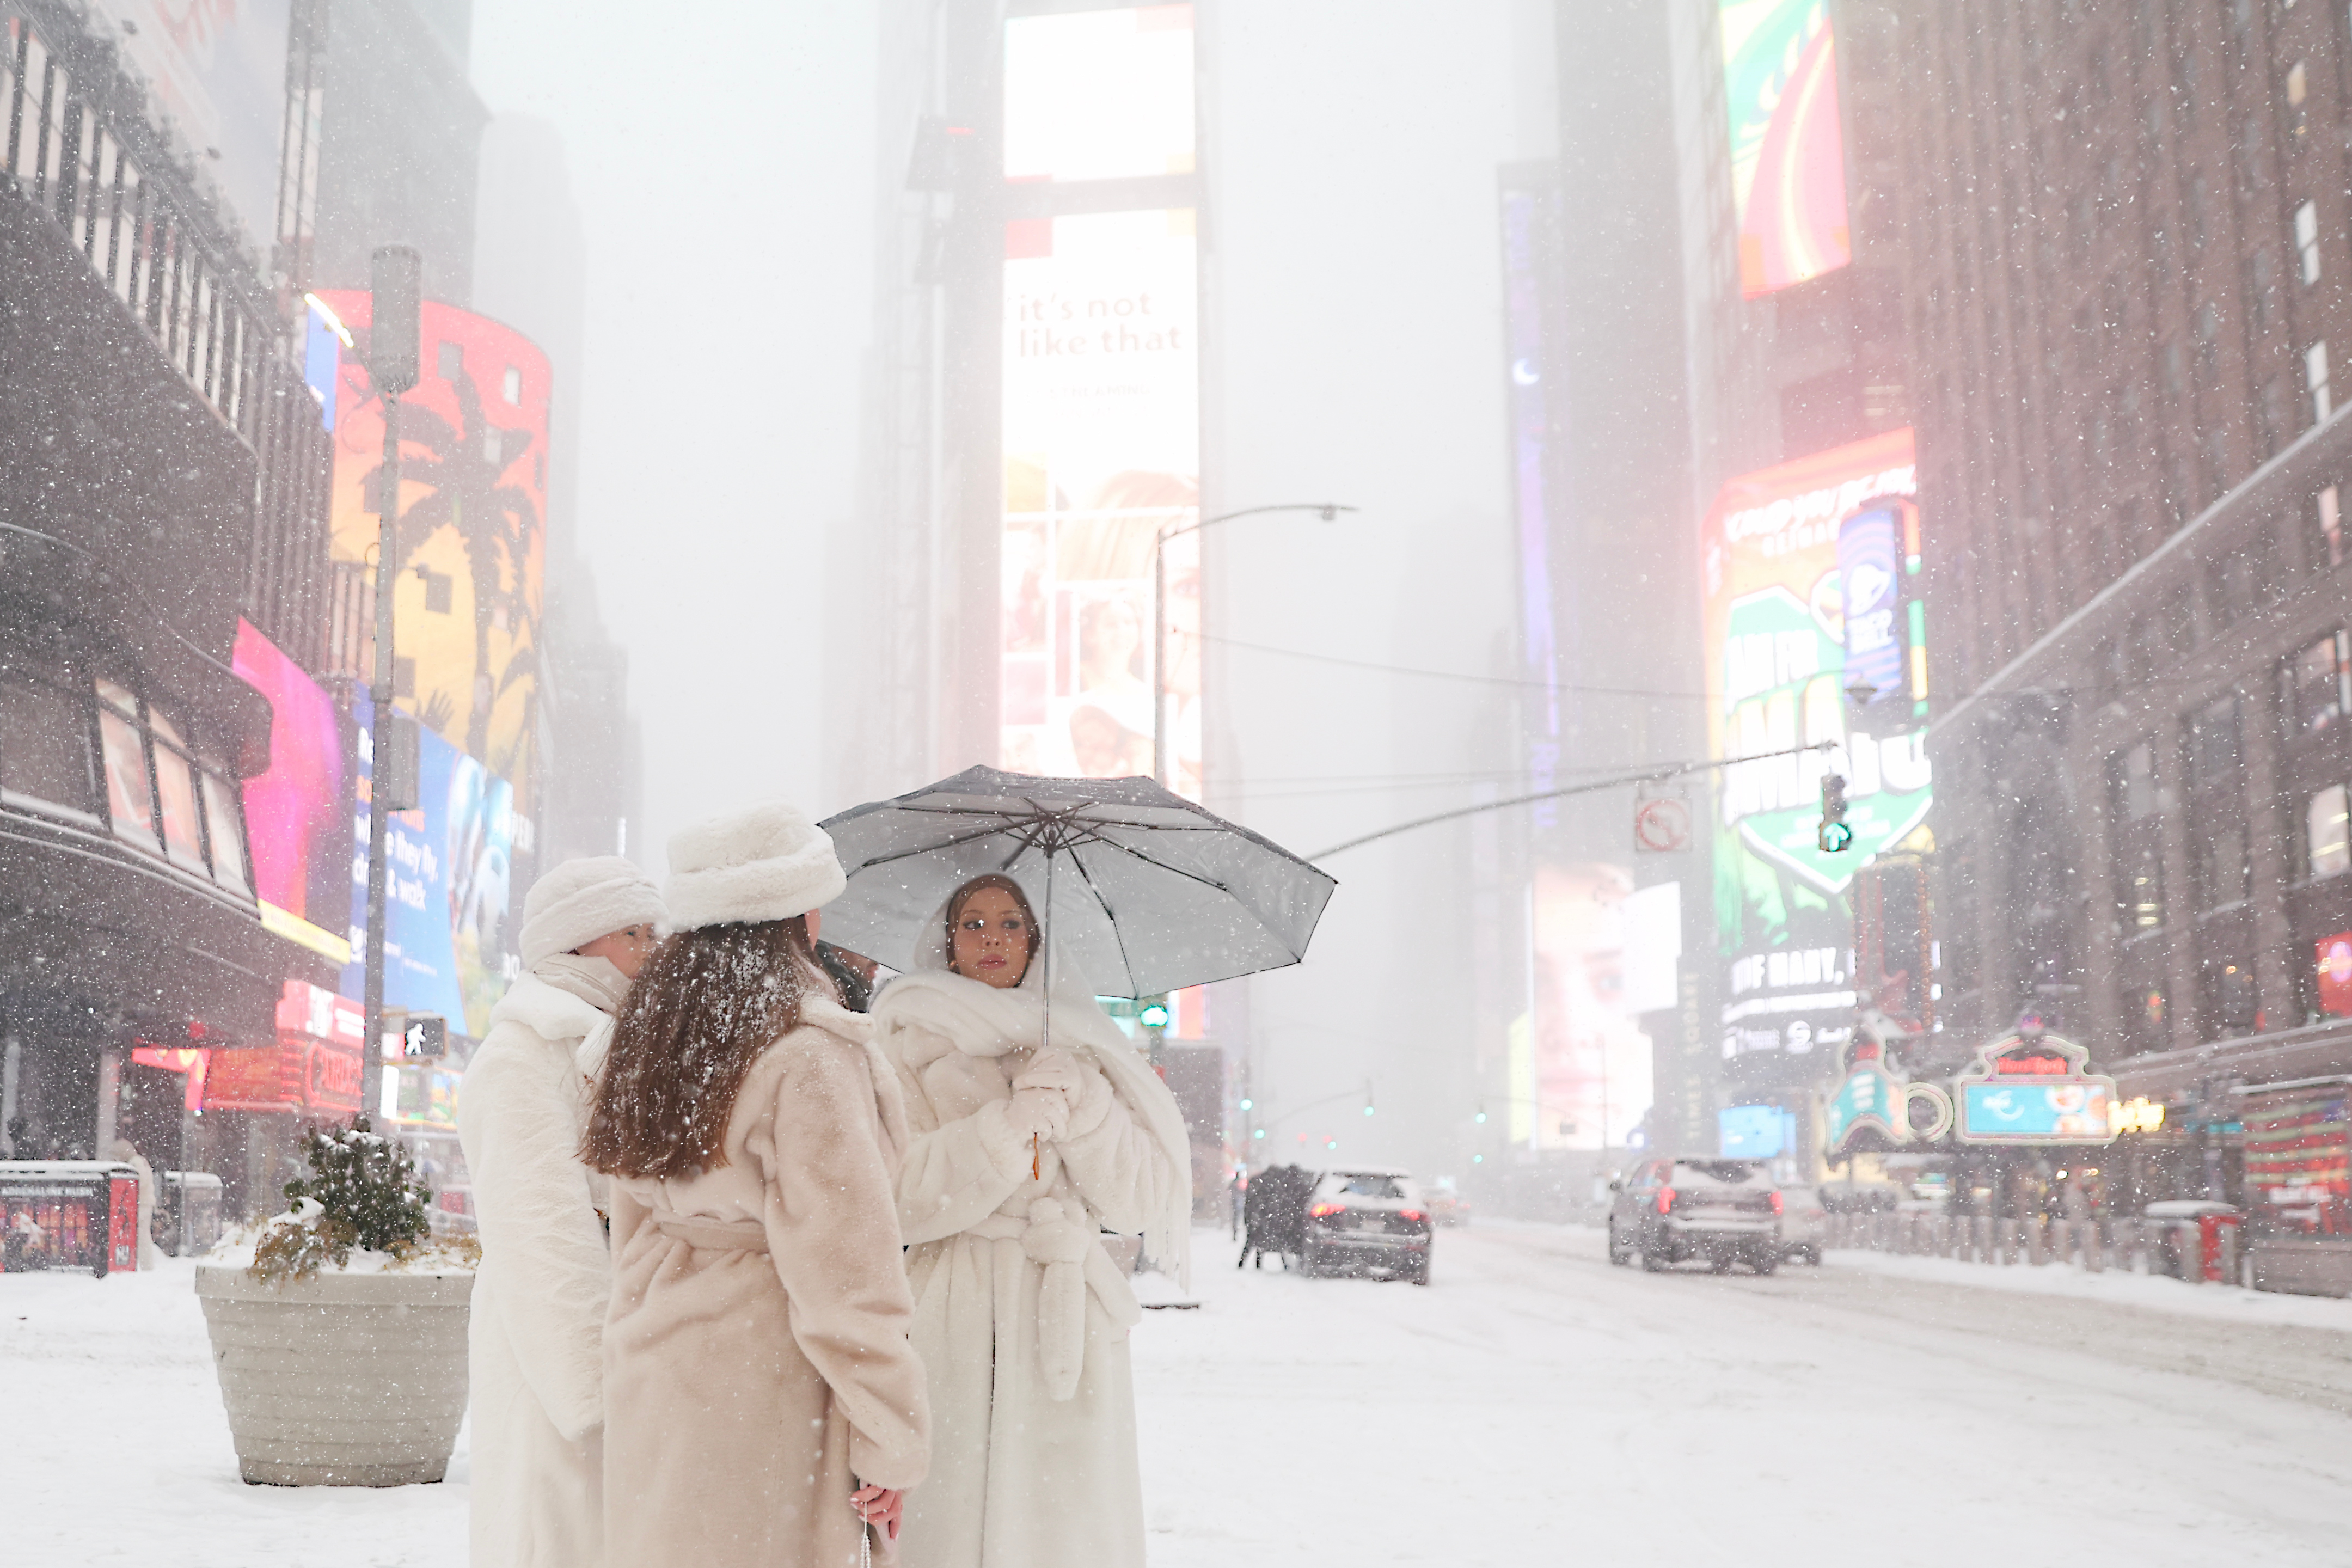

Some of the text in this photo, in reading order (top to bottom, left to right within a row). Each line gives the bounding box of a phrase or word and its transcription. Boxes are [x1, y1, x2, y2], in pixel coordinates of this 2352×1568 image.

[1020, 292, 1153, 322] it's not
[1020, 323, 1182, 357] like that
[384, 868, 398, 898] &
[1, 1186, 94, 1197] ADRENALINE RUSH
